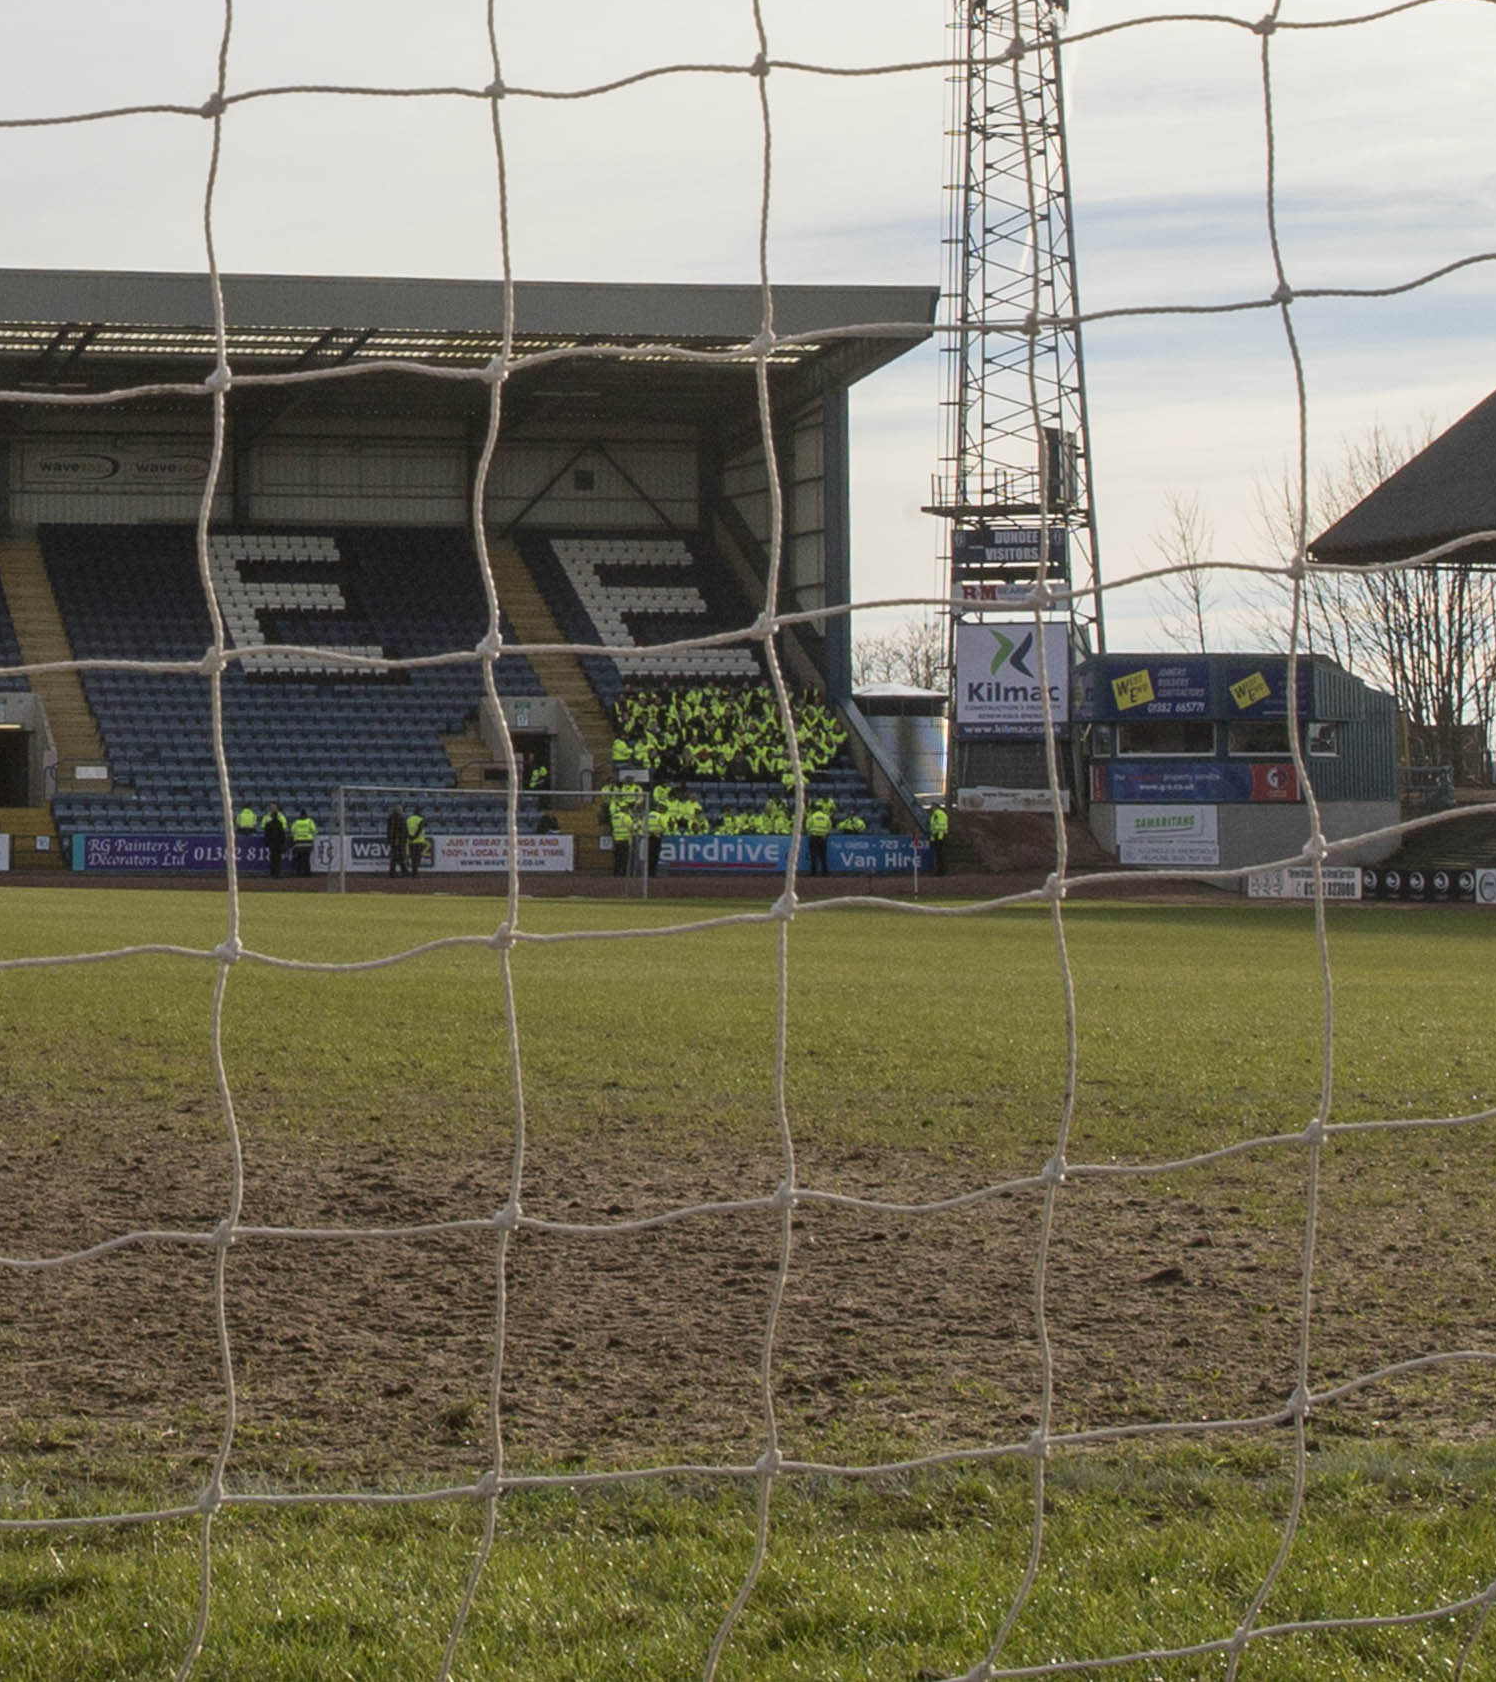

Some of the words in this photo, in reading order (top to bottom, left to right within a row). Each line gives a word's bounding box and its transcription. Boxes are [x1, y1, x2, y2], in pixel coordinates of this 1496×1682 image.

[994, 530, 1039, 544] DUNDEE
[984, 547, 1039, 561] VISITORS
[967, 681, 1060, 703] Kilmac
[87, 838, 111, 852] RG
[114, 838, 170, 852] Painters
[172, 838, 188, 851] &
[446, 838, 470, 847] JUST
[472, 838, 501, 847] GREAT
[539, 838, 559, 847] AND
[87, 853, 158, 867] Decorators
[161, 853, 186, 866] Ltd
[470, 849, 498, 858] LOCAL
[541, 849, 565, 858] TIME
[840, 852, 877, 868] Van
[885, 852, 922, 868] Hire
